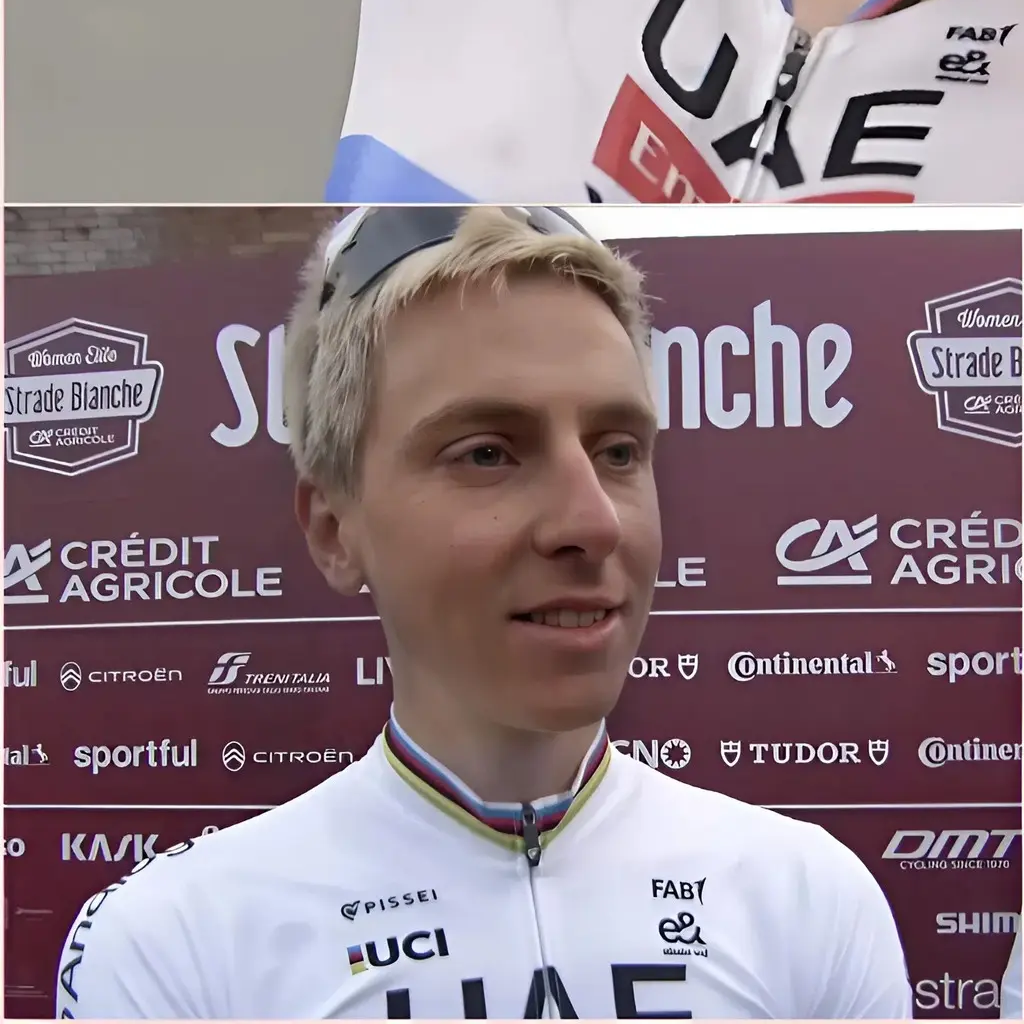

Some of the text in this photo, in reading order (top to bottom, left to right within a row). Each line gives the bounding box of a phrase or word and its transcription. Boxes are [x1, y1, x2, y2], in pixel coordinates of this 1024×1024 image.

[957, 308, 1022, 329] Women
[931, 345, 1003, 379] Strade
[5, 378, 143, 416] Strade Blanche
[889, 510, 1022, 549] CRÉD
[59, 532, 219, 570] CRÉDIT
[59, 567, 283, 603] AGRICOLE
[245, 672, 330, 686] TRENITALIA
[727, 651, 873, 682] Continental
[926, 646, 1022, 683] sport
[73, 738, 198, 775] sportful
[749, 742, 861, 764] TUDOR
[61, 832, 159, 862] KASK
[881, 829, 1022, 859] DMT
[365, 888, 438, 914] PISSEI
[935, 911, 1021, 934] SHIM
[365, 927, 450, 968] UCI
[915, 971, 1001, 1010] stra
